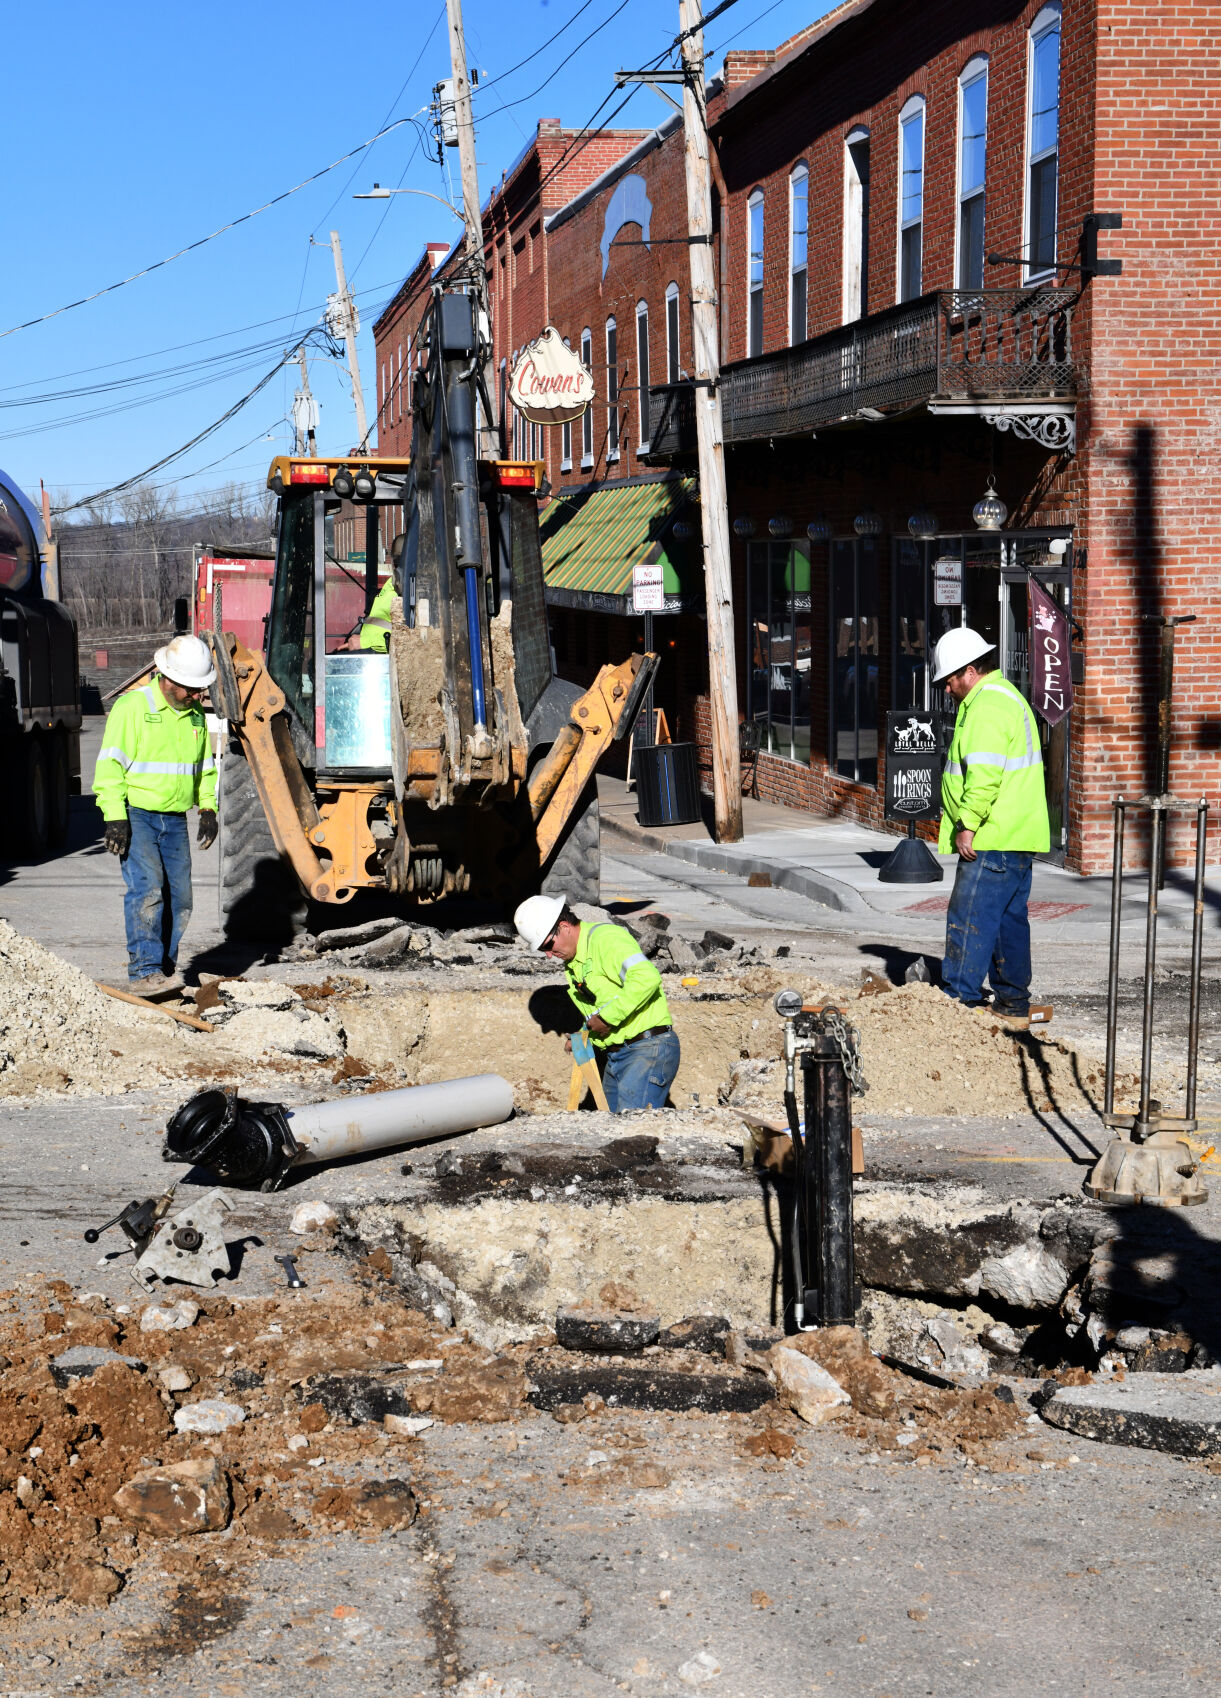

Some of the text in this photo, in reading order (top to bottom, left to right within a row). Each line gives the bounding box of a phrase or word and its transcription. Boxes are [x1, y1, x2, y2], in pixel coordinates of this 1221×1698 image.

[518, 360, 584, 396] Cowan's
[1043, 636, 1064, 711] OPEN
[906, 769, 932, 783] SPOON
[906, 783, 932, 798] RINGS
